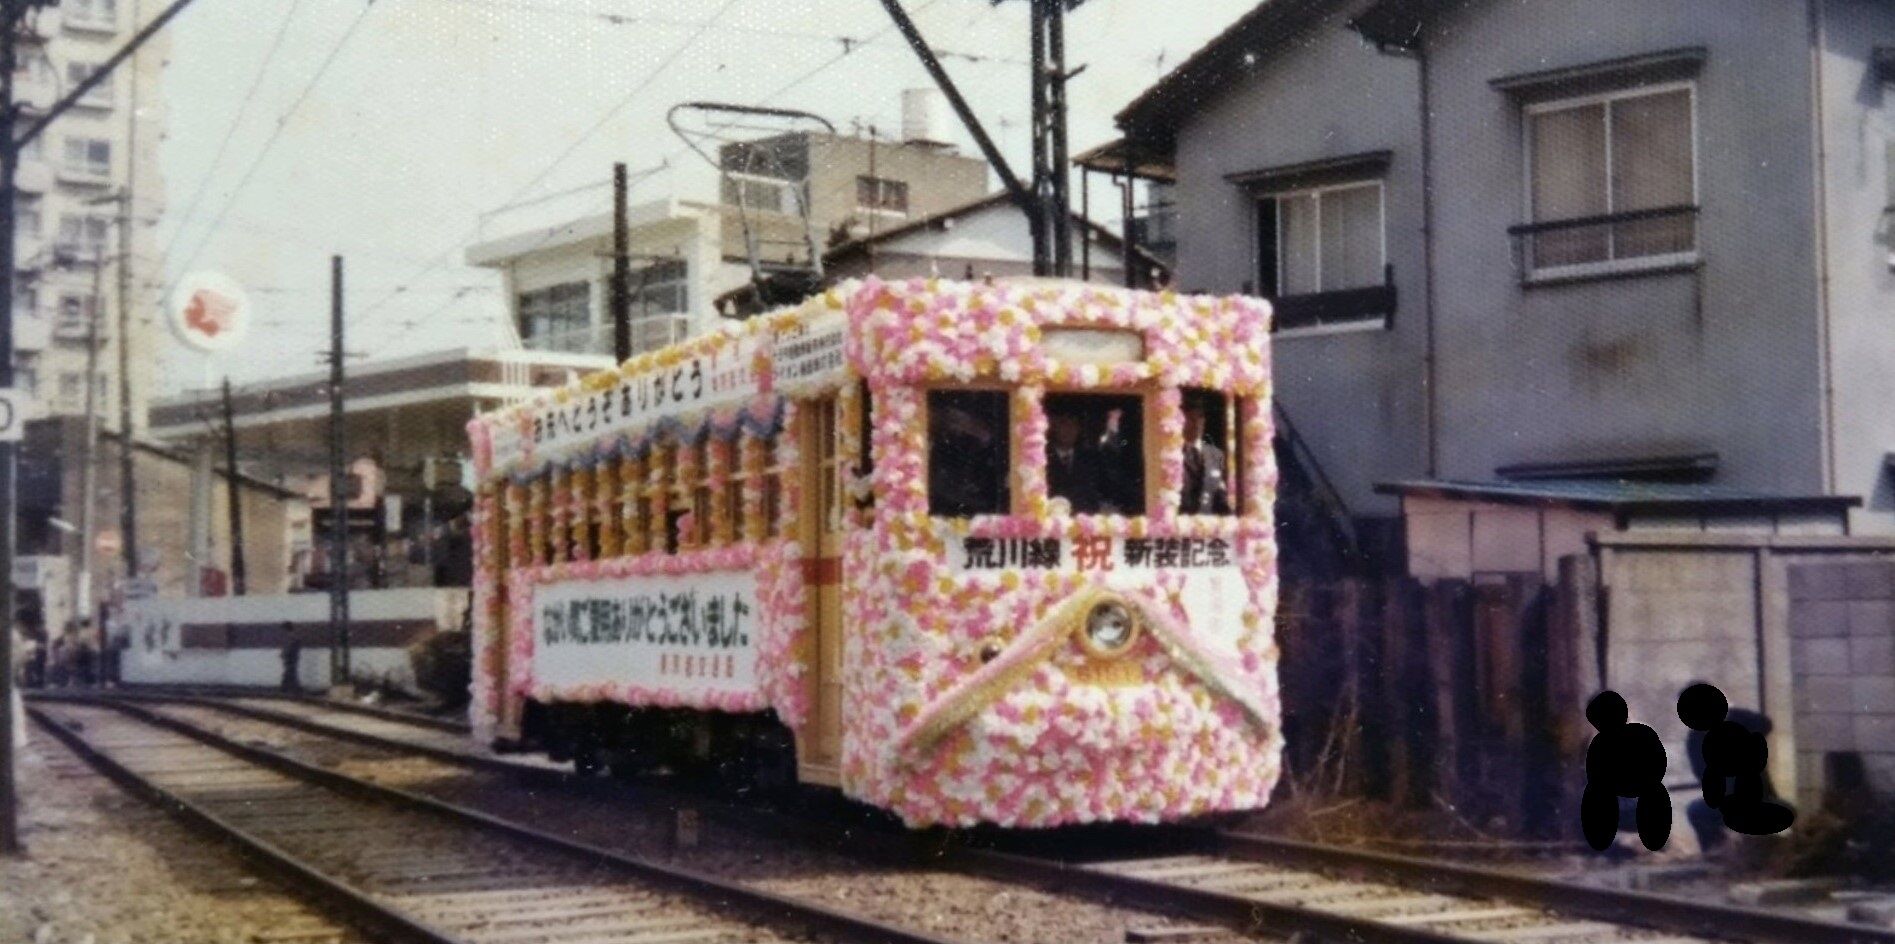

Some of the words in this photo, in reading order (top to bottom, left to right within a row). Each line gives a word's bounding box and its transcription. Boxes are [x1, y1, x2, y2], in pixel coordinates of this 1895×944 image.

[963, 537, 1061, 570] 荒川線
[1072, 536, 1113, 571] 祝
[1124, 537, 1231, 569] 新装記念
